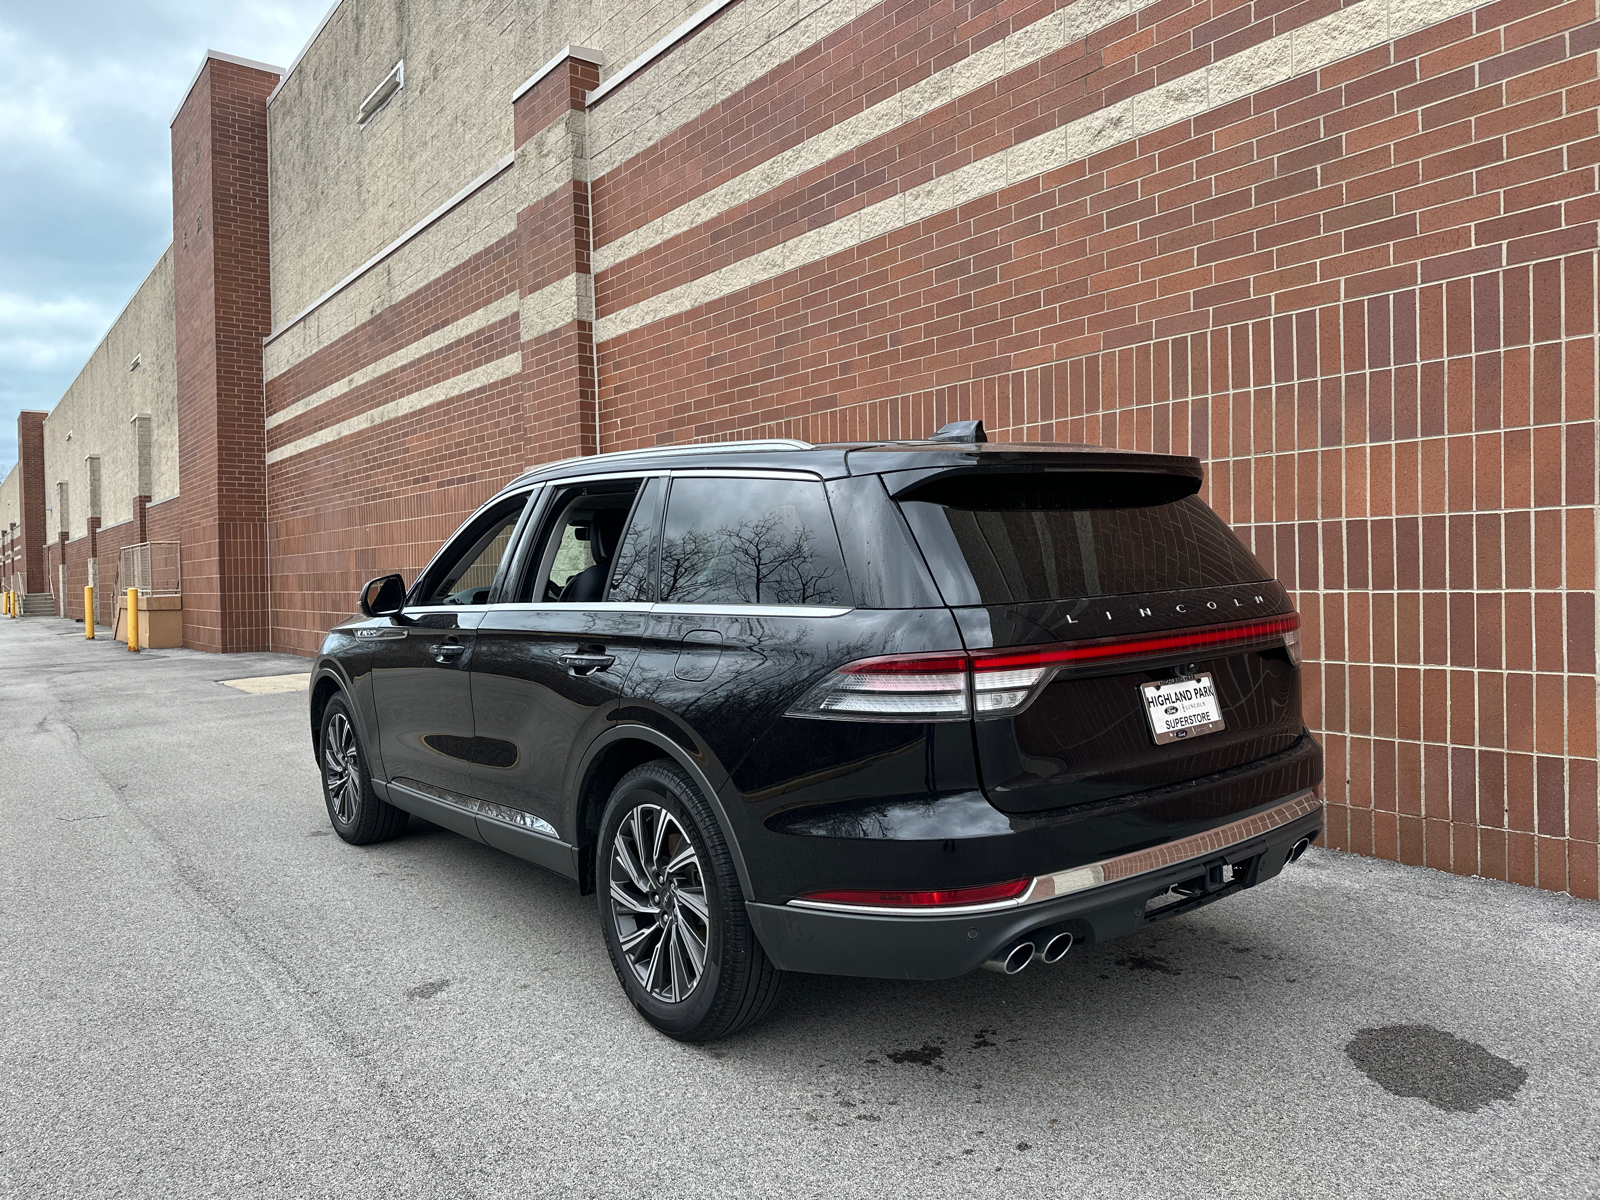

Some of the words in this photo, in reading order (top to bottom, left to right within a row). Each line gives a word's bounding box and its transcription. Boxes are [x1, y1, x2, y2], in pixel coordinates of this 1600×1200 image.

[1066, 595, 1264, 624] LINCOLN
[1147, 689, 1192, 708] HIGHLAND
[1193, 686, 1214, 699] PARK
[1185, 701, 1206, 710] LINCOLN
[1165, 711, 1211, 730] SUPERSTORE
